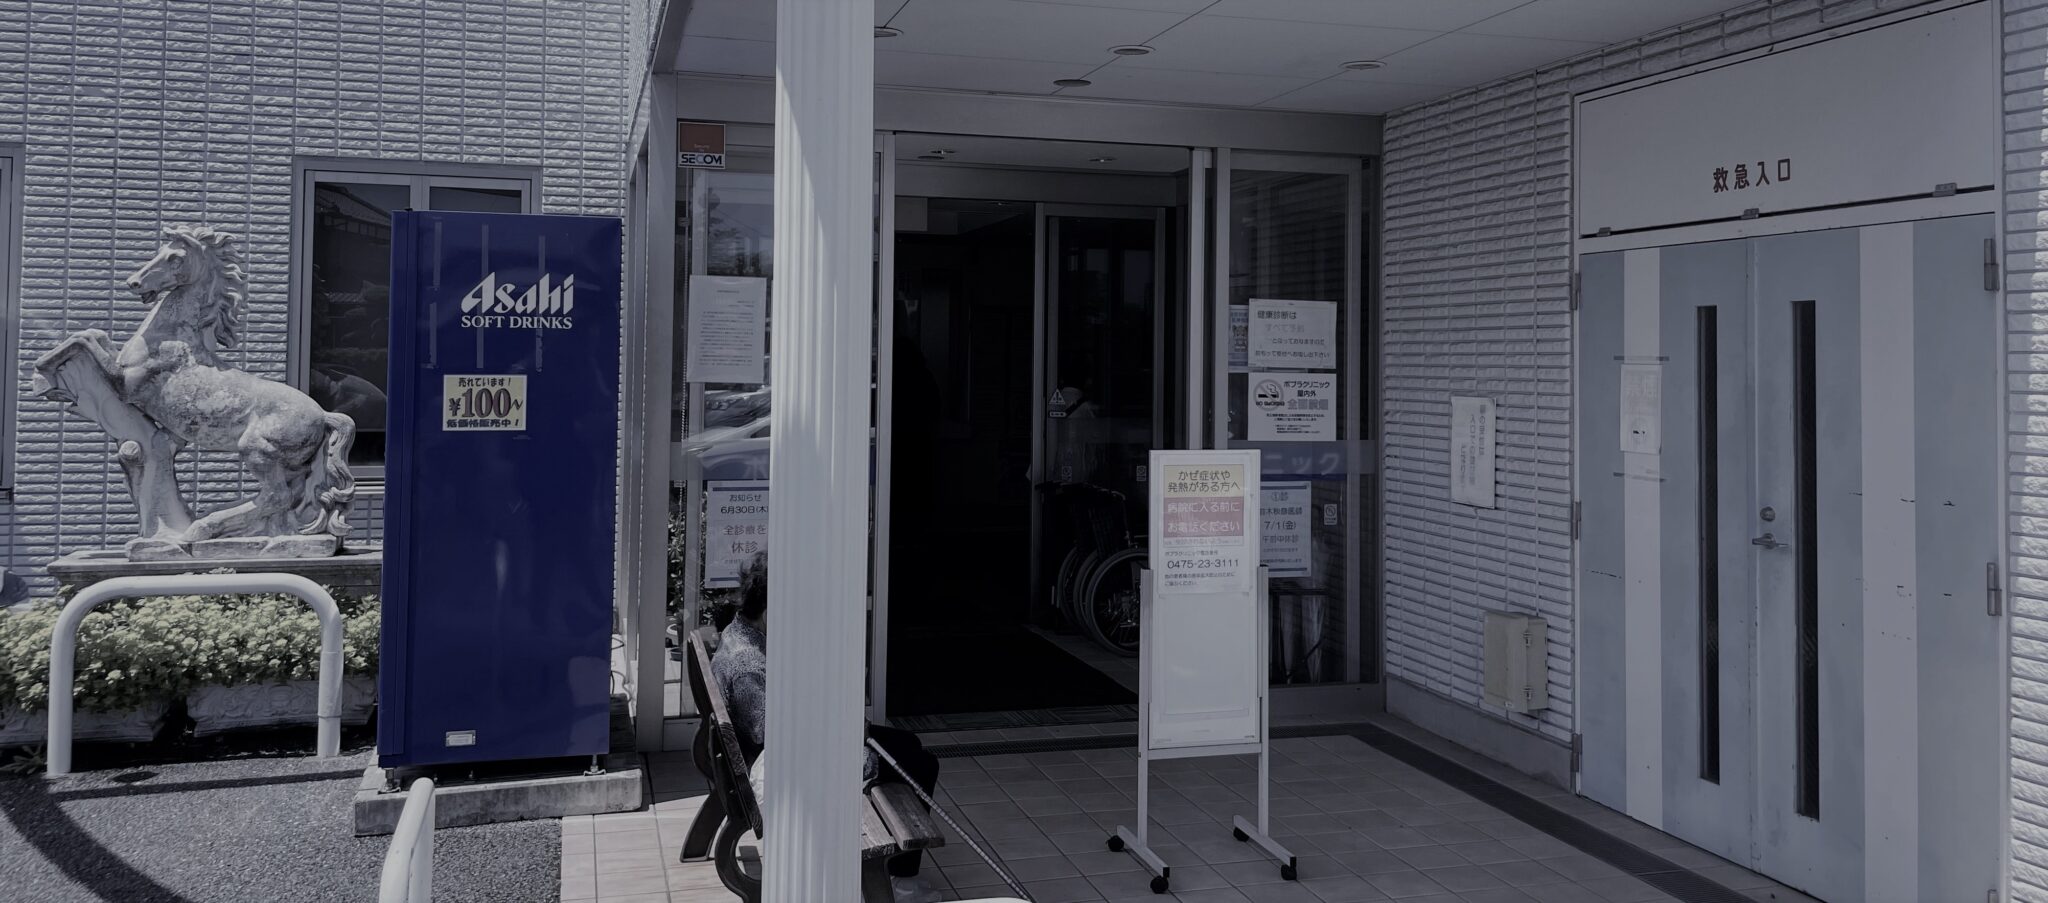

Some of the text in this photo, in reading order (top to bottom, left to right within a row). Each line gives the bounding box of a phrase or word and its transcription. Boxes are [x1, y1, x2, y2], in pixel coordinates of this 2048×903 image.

[681, 153, 722, 165] SECOM
[1712, 158, 1791, 193] 救急入口
[460, 271, 575, 315] Asahi
[1257, 310, 1297, 320] 健康診断は
[461, 315, 573, 330] SOFT DRINKS
[458, 377, 512, 387] 売れています！
[1283, 380, 1331, 388] ポプラクリニック
[1297, 389, 1317, 398] 屋内外
[1178, 469, 1231, 481] かぜ症状や
[1167, 481, 1241, 493] 発熱がある方へ
[729, 494, 762, 502] お知らせ
[1167, 502, 1241, 513] 病院に入る前に
[723, 525, 767, 536] 全診療を
[1167, 521, 1240, 533] お電話ください
[731, 541, 759, 554] 休診
[1167, 559, 1240, 569] 0475-23-3111
